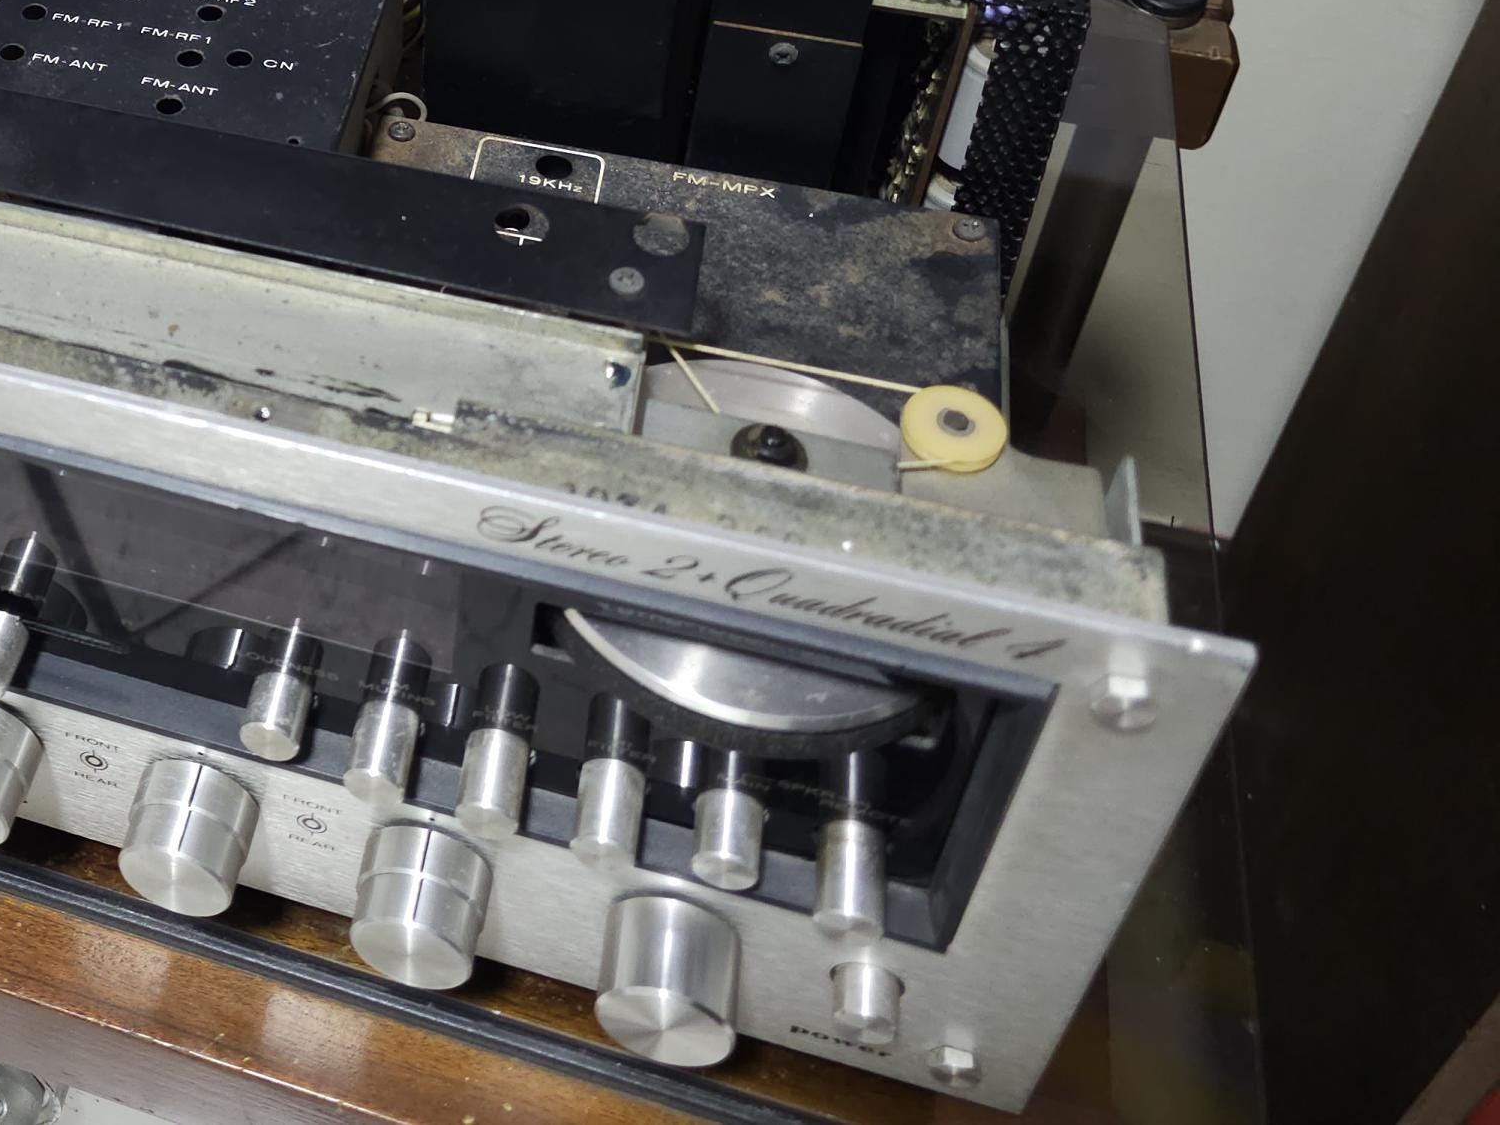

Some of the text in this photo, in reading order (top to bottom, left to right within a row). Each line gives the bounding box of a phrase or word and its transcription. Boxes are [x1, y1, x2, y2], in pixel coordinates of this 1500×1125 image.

[31, 52, 109, 72] FM-ANT
[262, 58, 295, 71] CN
[140, 76, 220, 97] FM-ANT
[518, 174, 583, 195] 19KHz
[672, 171, 777, 200] FM-MPX
[476, 505, 630, 567] Stereo
[724, 566, 1013, 650] Quadradial
[64, 730, 121, 754] FRONT
[281, 793, 343, 816] FRONT
[788, 1024, 893, 1058] power
